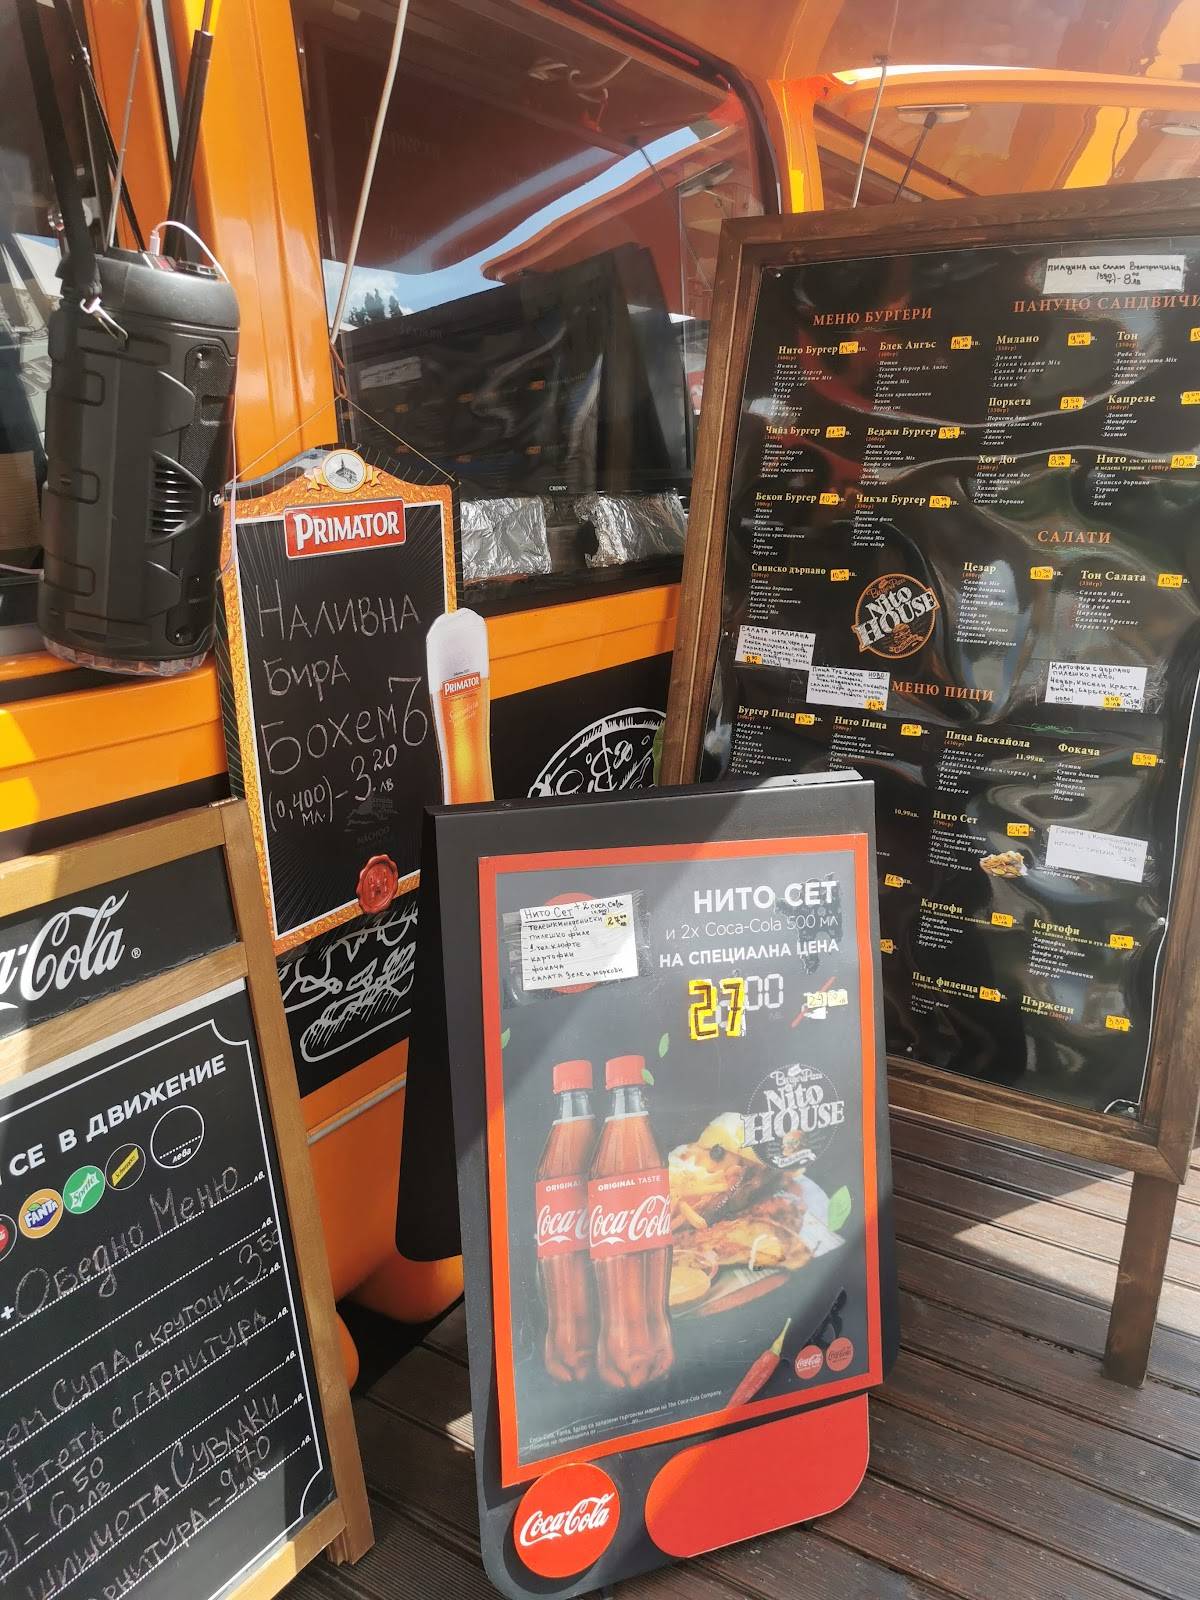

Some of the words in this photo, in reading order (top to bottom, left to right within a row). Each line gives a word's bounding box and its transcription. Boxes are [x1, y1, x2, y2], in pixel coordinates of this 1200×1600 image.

[1014, 298, 1090, 313] ПАНУЦО
[1098, 295, 1200, 312] САНДВИЧИ
[813, 313, 860, 326] МЕНЮ
[865, 307, 933, 324] БУРГЕРИ
[996, 335, 1040, 345] Милано
[1117, 331, 1138, 341] Тон
[778, 345, 803, 355] Нито
[805, 345, 838, 356] Бургер
[880, 342, 902, 351] Блек
[905, 341, 937, 351] Ангъс
[989, 398, 1031, 409] Поркета
[1108, 395, 1156, 406] Капрезе
[790, 428, 821, 438] Бургер
[867, 428, 899, 437] Веджи
[902, 427, 937, 438] Бургер
[978, 455, 996, 464] Хот
[998, 455, 1017, 466] Дог
[1096, 455, 1127, 464] Нито
[755, 492, 783, 501] Бекон
[785, 493, 817, 504] Бургер
[856, 494, 889, 504] Чикън
[891, 495, 926, 505] Бургер
[293, 508, 400, 551] PRIMATOR
[1037, 530, 1112, 544] САЛАТИ
[751, 564, 788, 573] Свинско
[789, 567, 826, 576] дърпано
[964, 562, 996, 574] Цезар
[1081, 571, 1103, 580] Тон
[1106, 571, 1146, 582] Салата
[866, 586, 912, 617] Nito
[256, 579, 421, 640] НАЛИВНА
[857, 592, 938, 647] HOUSE
[444, 676, 480, 696] PRIMATOR
[892, 681, 940, 696] МЕНЮ
[944, 686, 994, 702] ПИЦИ
[738, 706, 769, 717] Бургер
[771, 708, 795, 719] Пица
[834, 716, 860, 727] Нито
[861, 717, 887, 730] Пица
[945, 731, 973, 742] Пица
[975, 733, 1030, 748] Баскайола
[1058, 743, 1100, 757] Фокача
[933, 809, 957, 821] Нито
[960, 813, 978, 825] Сет
[694, 886, 774, 914] НИТО
[785, 881, 838, 907] СЕТ
[921, 898, 963, 914] Картофи
[524, 909, 551, 921] Нито
[553, 907, 574, 918] Сет
[666, 928, 676, 940] и
[705, 918, 782, 938] Coca-Cola
[786, 915, 816, 930] 500
[820, 916, 839, 927] мл
[1034, 919, 1080, 935] Картофи
[660, 953, 684, 968] НА
[689, 943, 791, 965] СПЕЦИАЛНА
[797, 939, 840, 957] ЦЕНА
[912, 971, 933, 984] Пил.
[936, 976, 978, 993] филенца
[1022, 995, 1074, 1014] Пържени
[764, 1083, 824, 1112] Nito
[9, 1144, 46, 1176] СЕ
[58, 1128, 78, 1153] В
[86, 1054, 226, 1142] ДВИЖЕНИЕ
[741, 1100, 845, 1147] HOUSE
[172, 1148, 192, 1163] лева
[253, 1171, 266, 1183] лв.
[598, 1179, 635, 1192] ORIGINAL
[638, 1175, 661, 1185] TASTE
[72, 1174, 97, 1207] Sprite
[24, 1199, 58, 1228] FANTA
[260, 1217, 273, 1229] лв.
[590, 1194, 671, 1248] Coca-Cola
[268, 1262, 281, 1275] лв.
[276, 1306, 289, 1320] лв.
[285, 1350, 297, 1364] лв.
[292, 1393, 304, 1405] лв.
[300, 1435, 312, 1448] лв.
[519, 1490, 616, 1547] Coca-Cola
